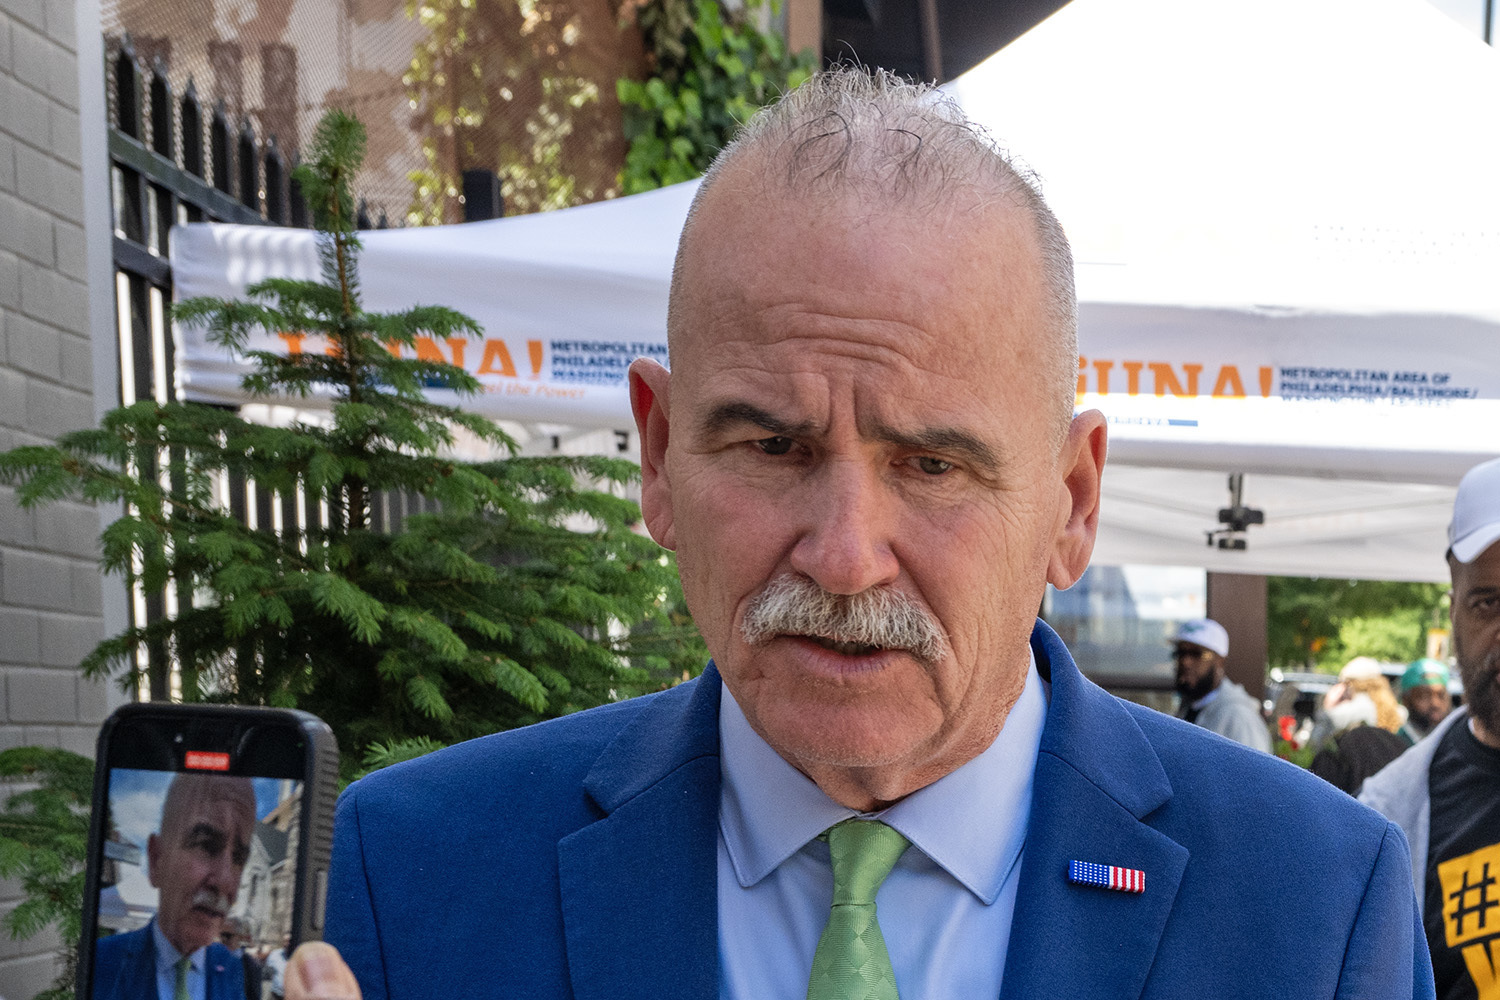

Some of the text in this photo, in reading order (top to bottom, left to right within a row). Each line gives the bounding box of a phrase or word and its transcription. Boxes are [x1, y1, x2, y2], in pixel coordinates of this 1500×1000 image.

[551, 340, 668, 354] METROPOLITAN
[1280, 367, 1451, 384] METROPOLITAN AREA OF
